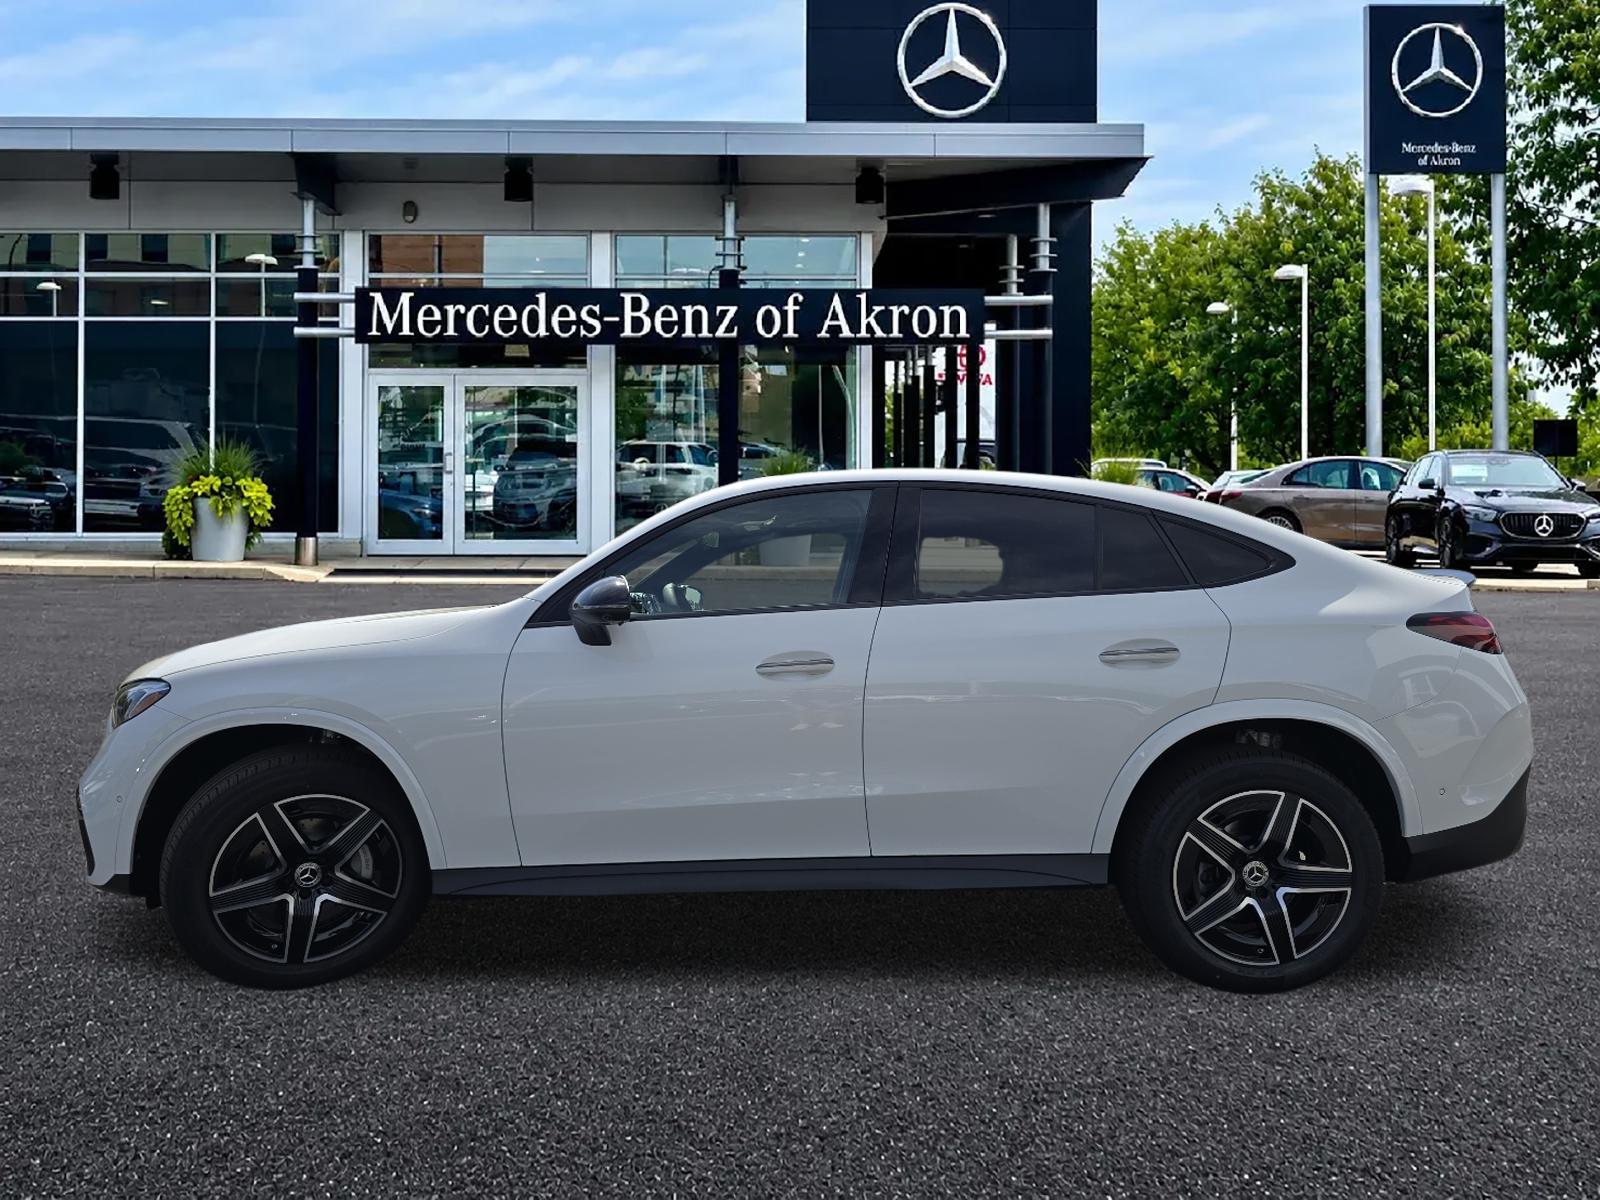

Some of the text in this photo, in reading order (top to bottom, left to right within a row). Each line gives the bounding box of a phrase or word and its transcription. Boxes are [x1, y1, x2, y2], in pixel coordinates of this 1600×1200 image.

[1401, 142, 1476, 153] Mercedes-Benz
[1417, 154, 1461, 165] of Akron
[367, 290, 971, 339] Mercedes-Benz of Akron
